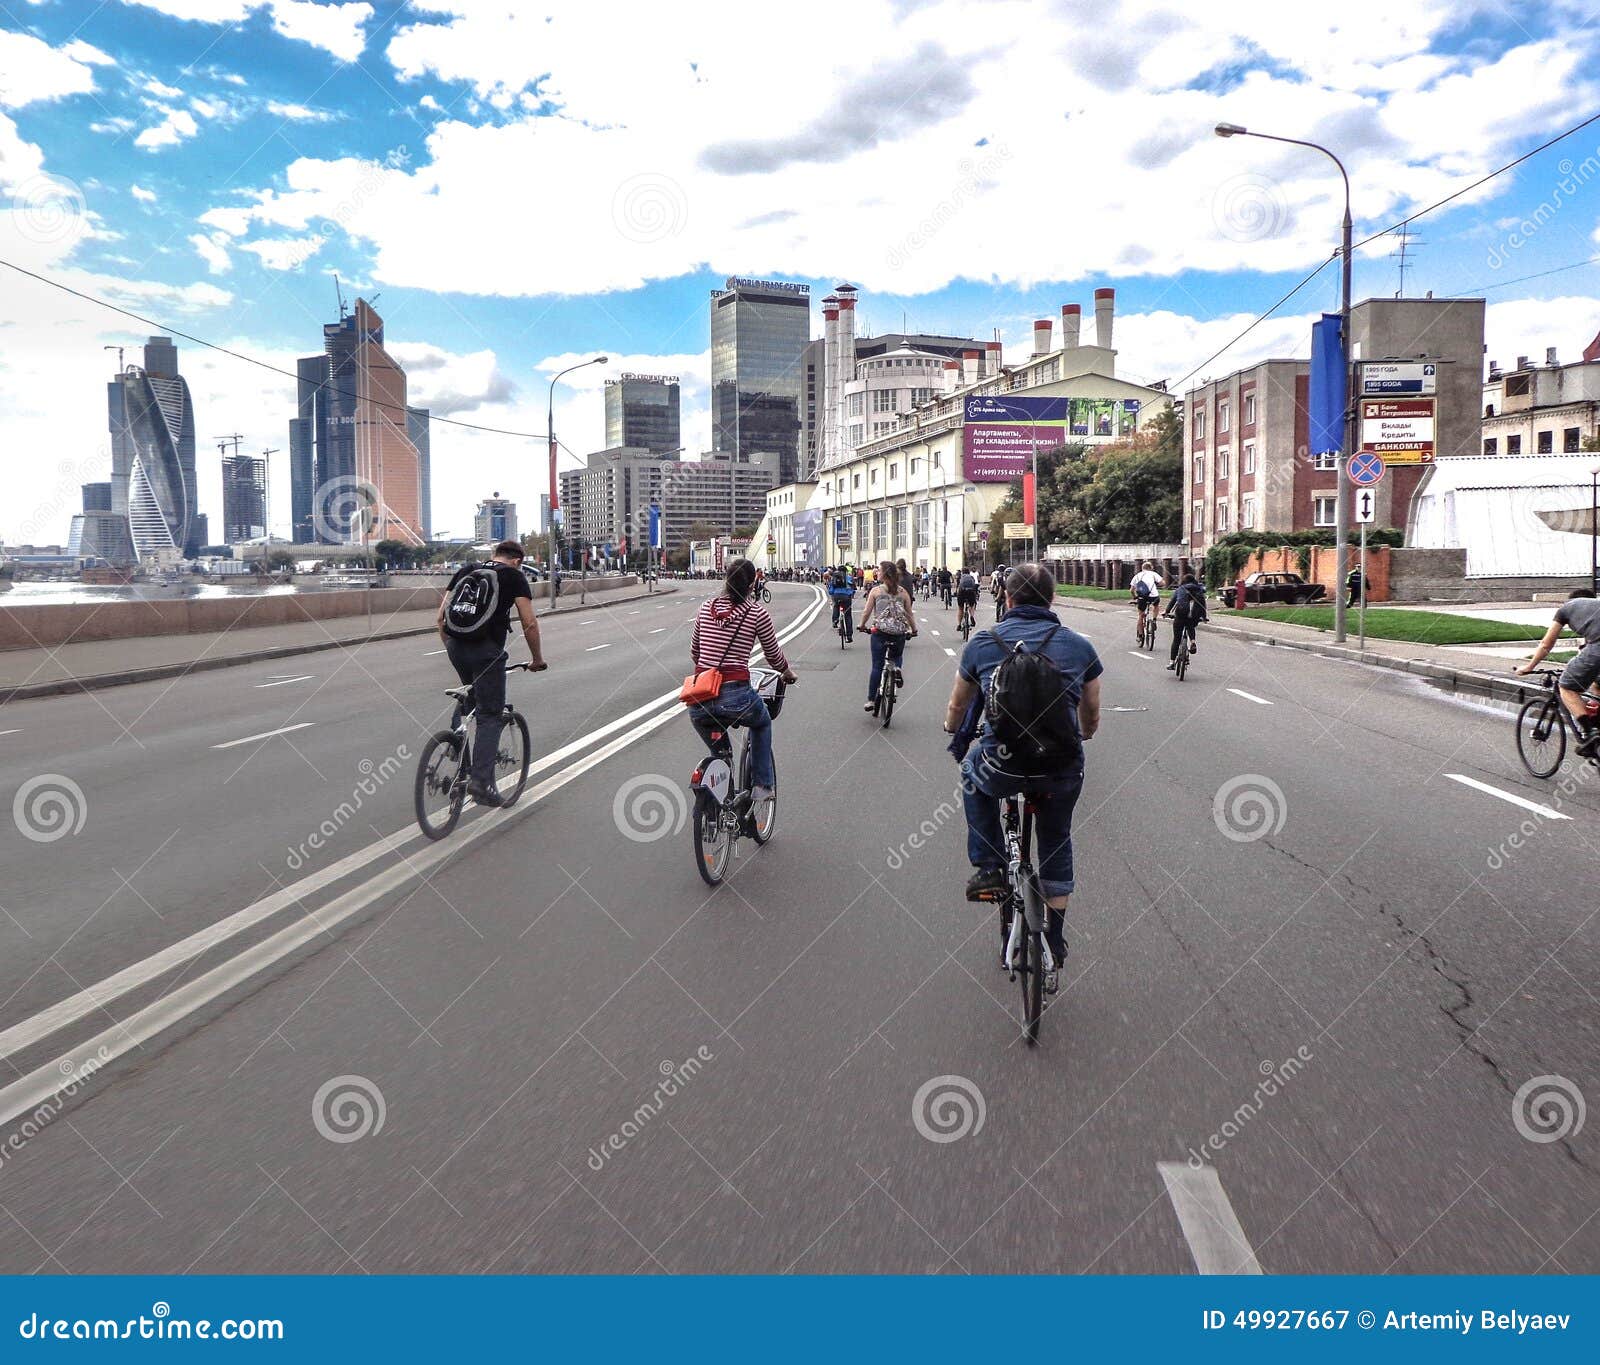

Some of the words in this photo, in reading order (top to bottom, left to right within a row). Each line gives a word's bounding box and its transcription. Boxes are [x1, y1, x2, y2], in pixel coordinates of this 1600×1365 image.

[735, 278, 760, 288] WORLD
[762, 280, 784, 289] TRADE
[785, 282, 811, 293] CENTER
[973, 429, 1022, 438] Апартаменты,
[1374, 442, 1425, 451] БАНКОМАТ
